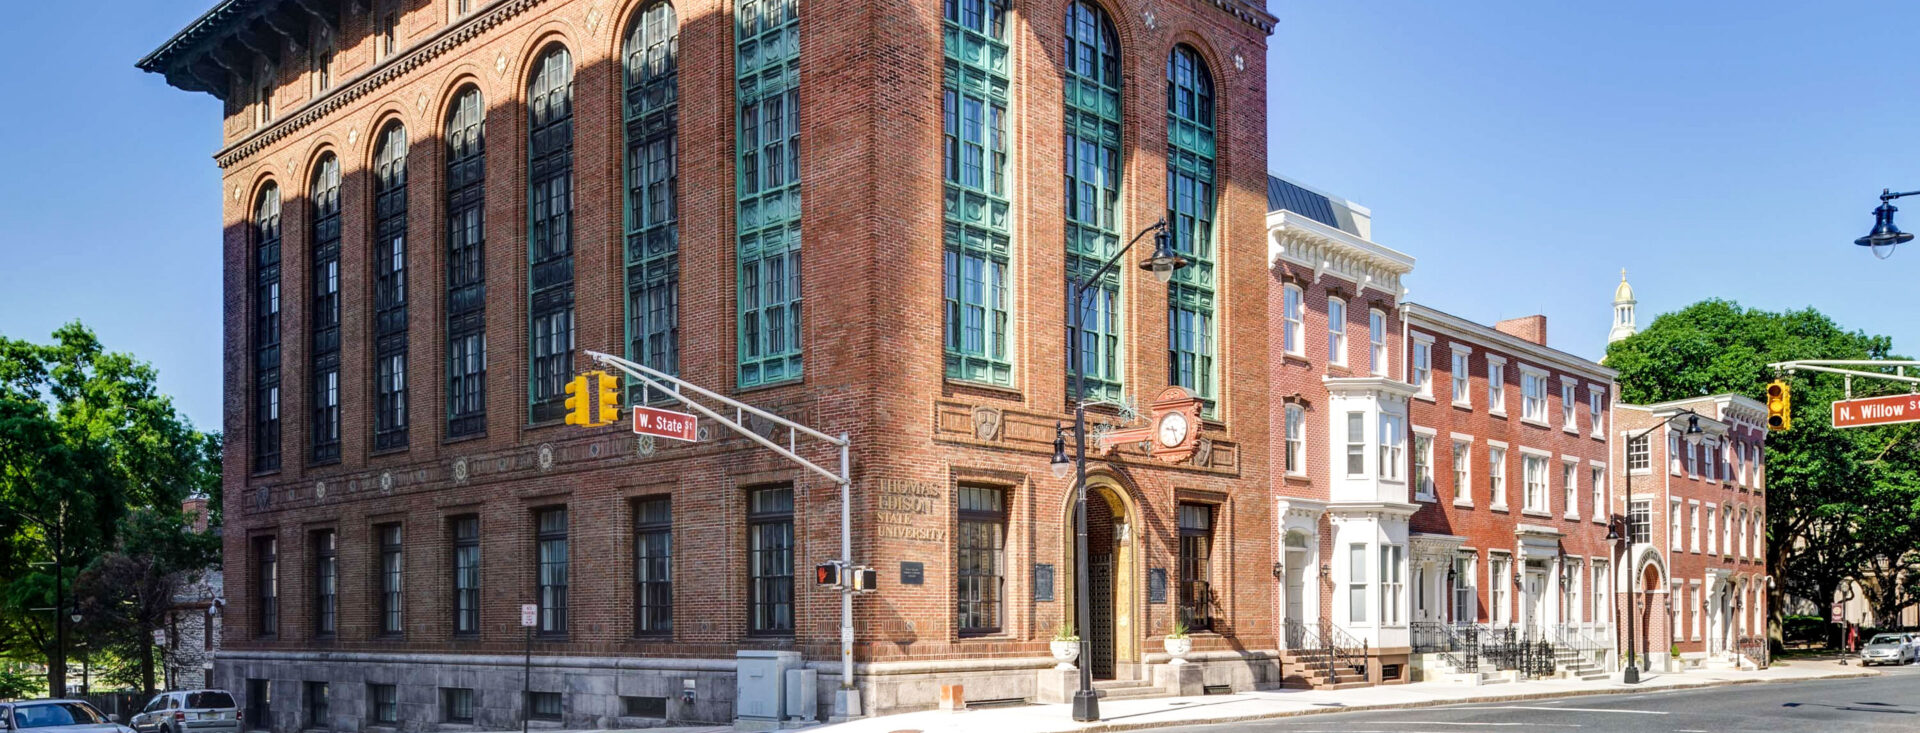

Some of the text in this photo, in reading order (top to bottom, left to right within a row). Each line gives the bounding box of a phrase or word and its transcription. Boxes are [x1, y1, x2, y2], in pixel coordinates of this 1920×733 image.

[1840, 406, 1855, 421] N.
[1861, 403, 1904, 419] Willow
[639, 413, 693, 433] W. State St
[878, 478, 940, 497] THOMAS
[878, 495, 934, 514] EDISON
[877, 511, 912, 524] STATE
[877, 525, 945, 540] UNIVERSITY
